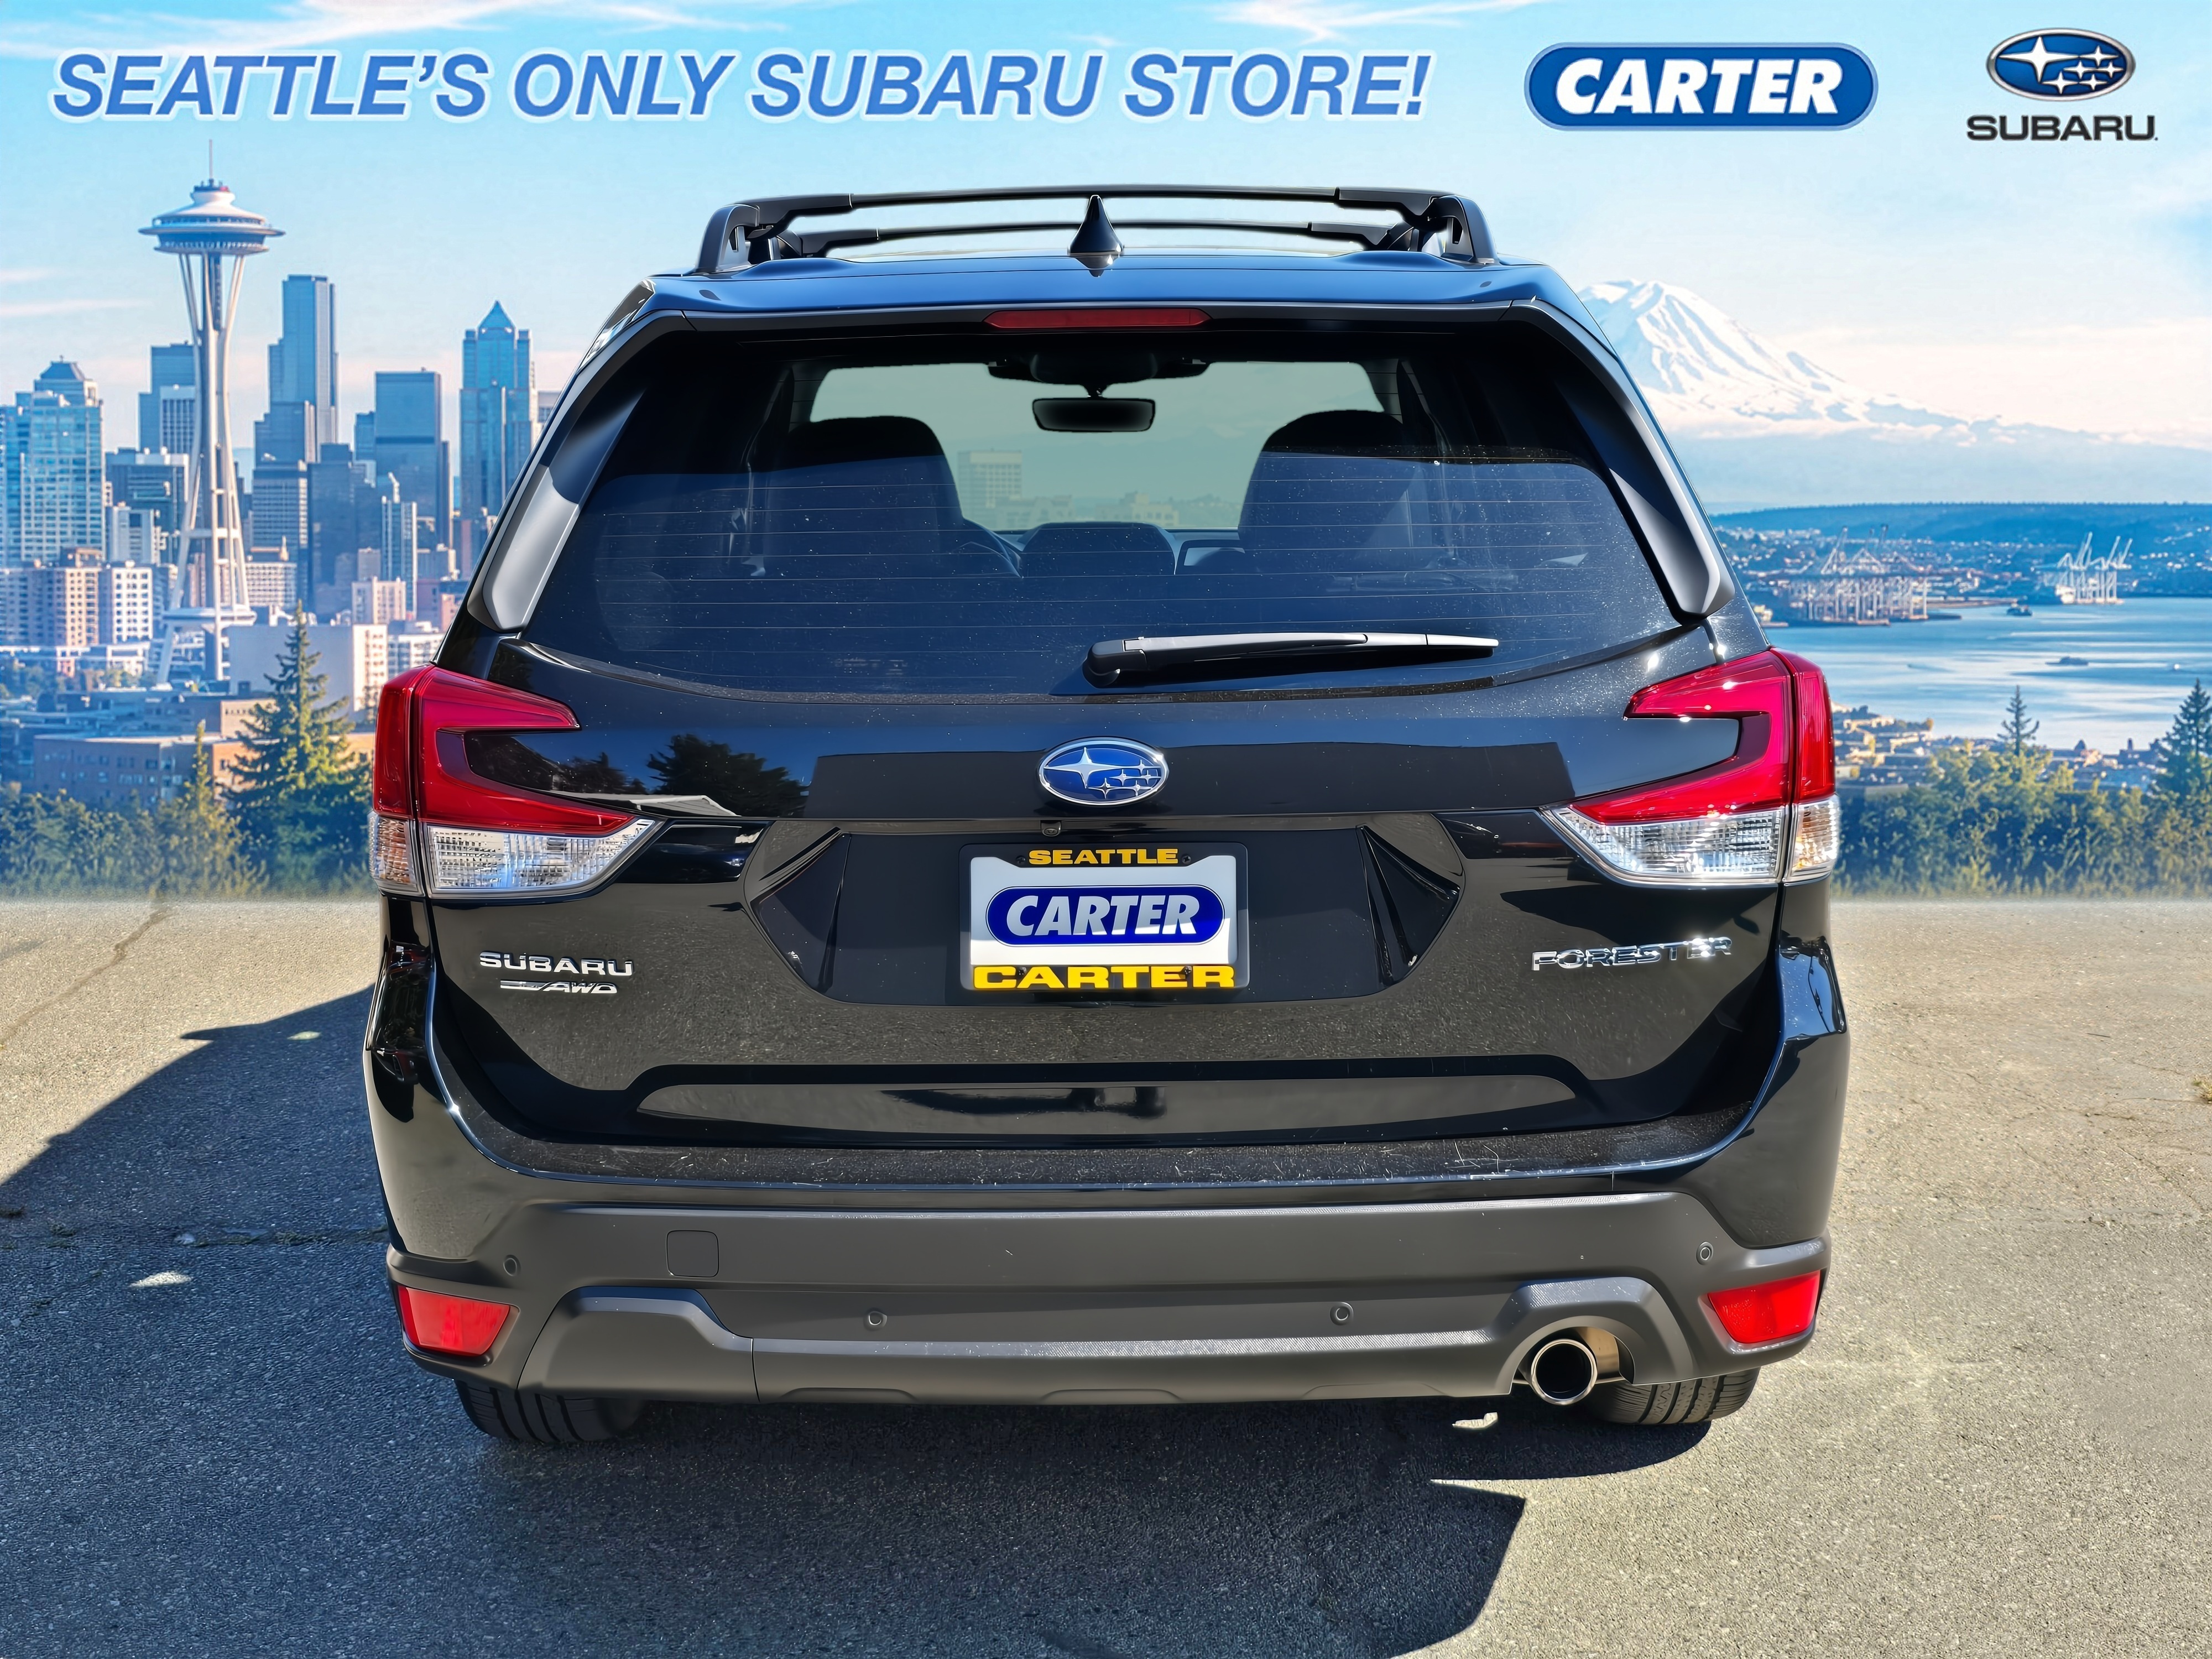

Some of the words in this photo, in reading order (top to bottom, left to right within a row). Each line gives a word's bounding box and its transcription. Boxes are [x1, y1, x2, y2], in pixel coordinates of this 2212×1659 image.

[1028, 848, 1178, 865] SEATTLE
[1006, 895, 1200, 936] CARTER
[479, 951, 633, 976] SUBARU
[1531, 937, 1733, 971] FORESTER
[542, 981, 618, 994] AWD
[973, 966, 1235, 988] CARTER
